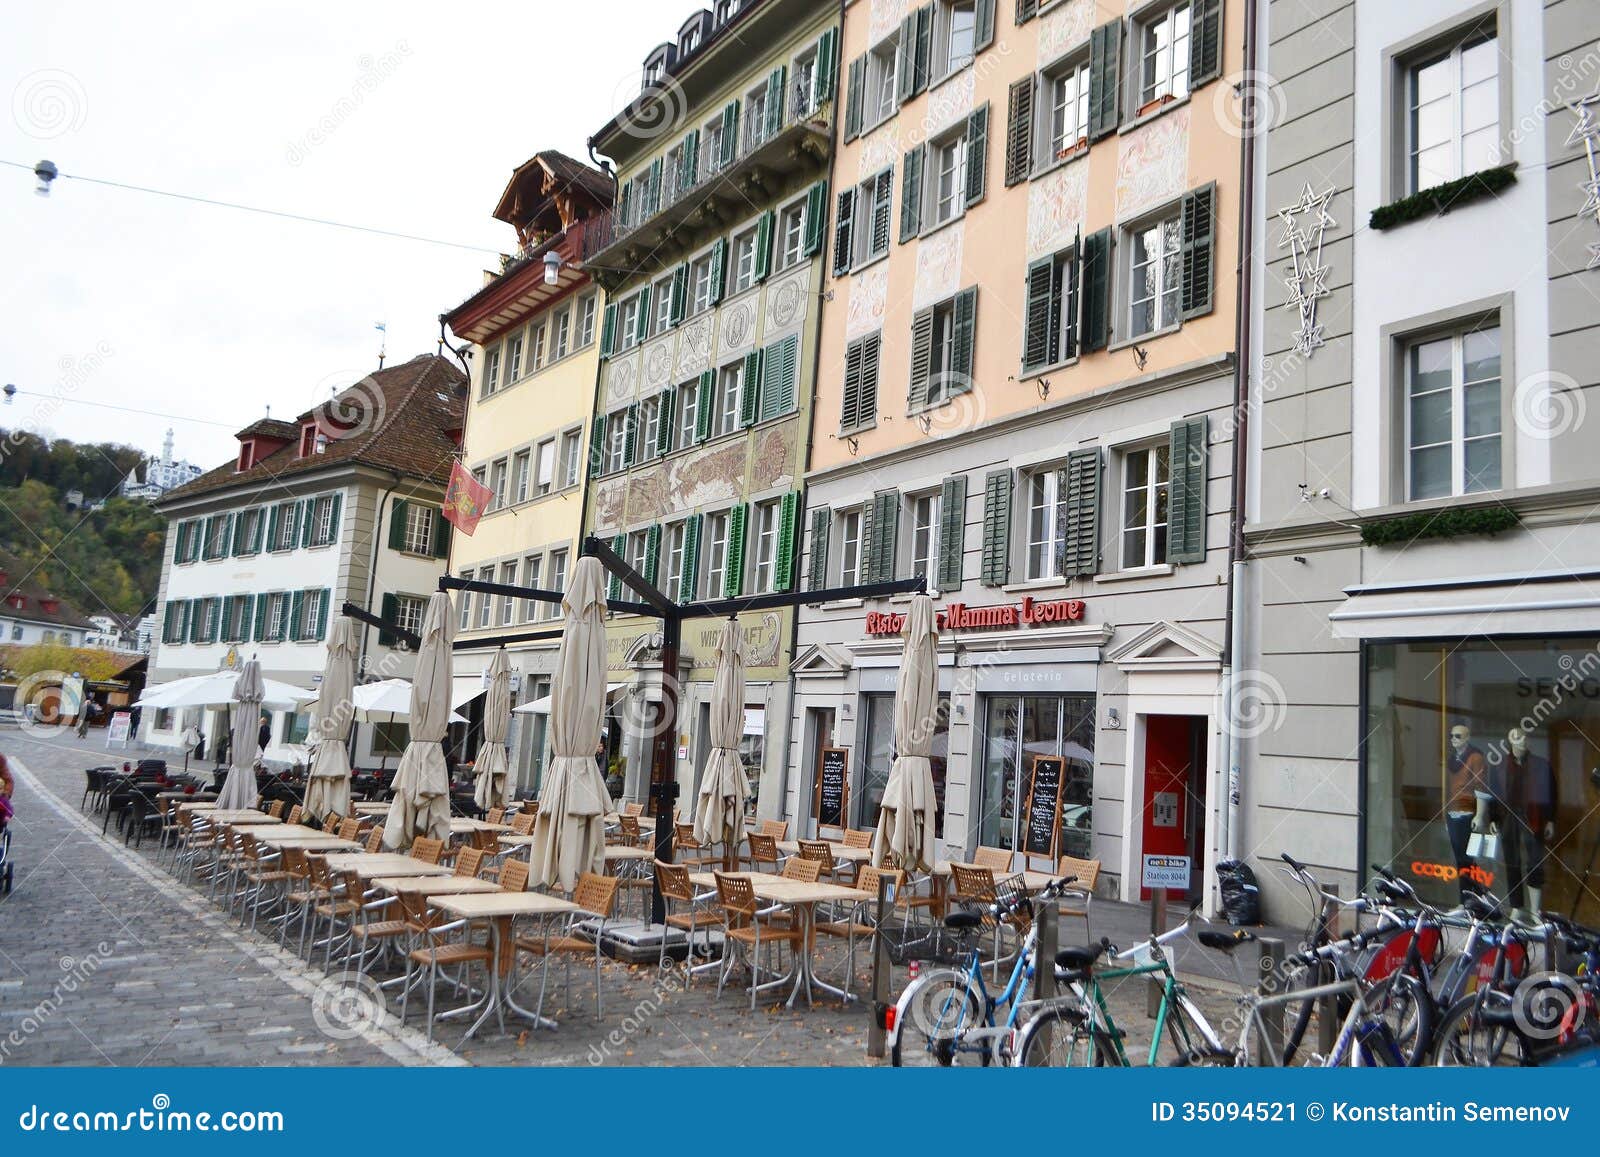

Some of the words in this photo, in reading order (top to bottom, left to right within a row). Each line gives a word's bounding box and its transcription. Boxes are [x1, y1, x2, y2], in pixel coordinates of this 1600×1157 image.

[866, 611, 944, 635] Risto
[944, 603, 1019, 629] Mamma
[1022, 596, 1086, 624] Leone
[700, 626, 764, 648] WIRAFT
[1003, 670, 1062, 682] Gelateria
[1146, 871, 1169, 881] Station
[1170, 872, 1186, 881] 8044
